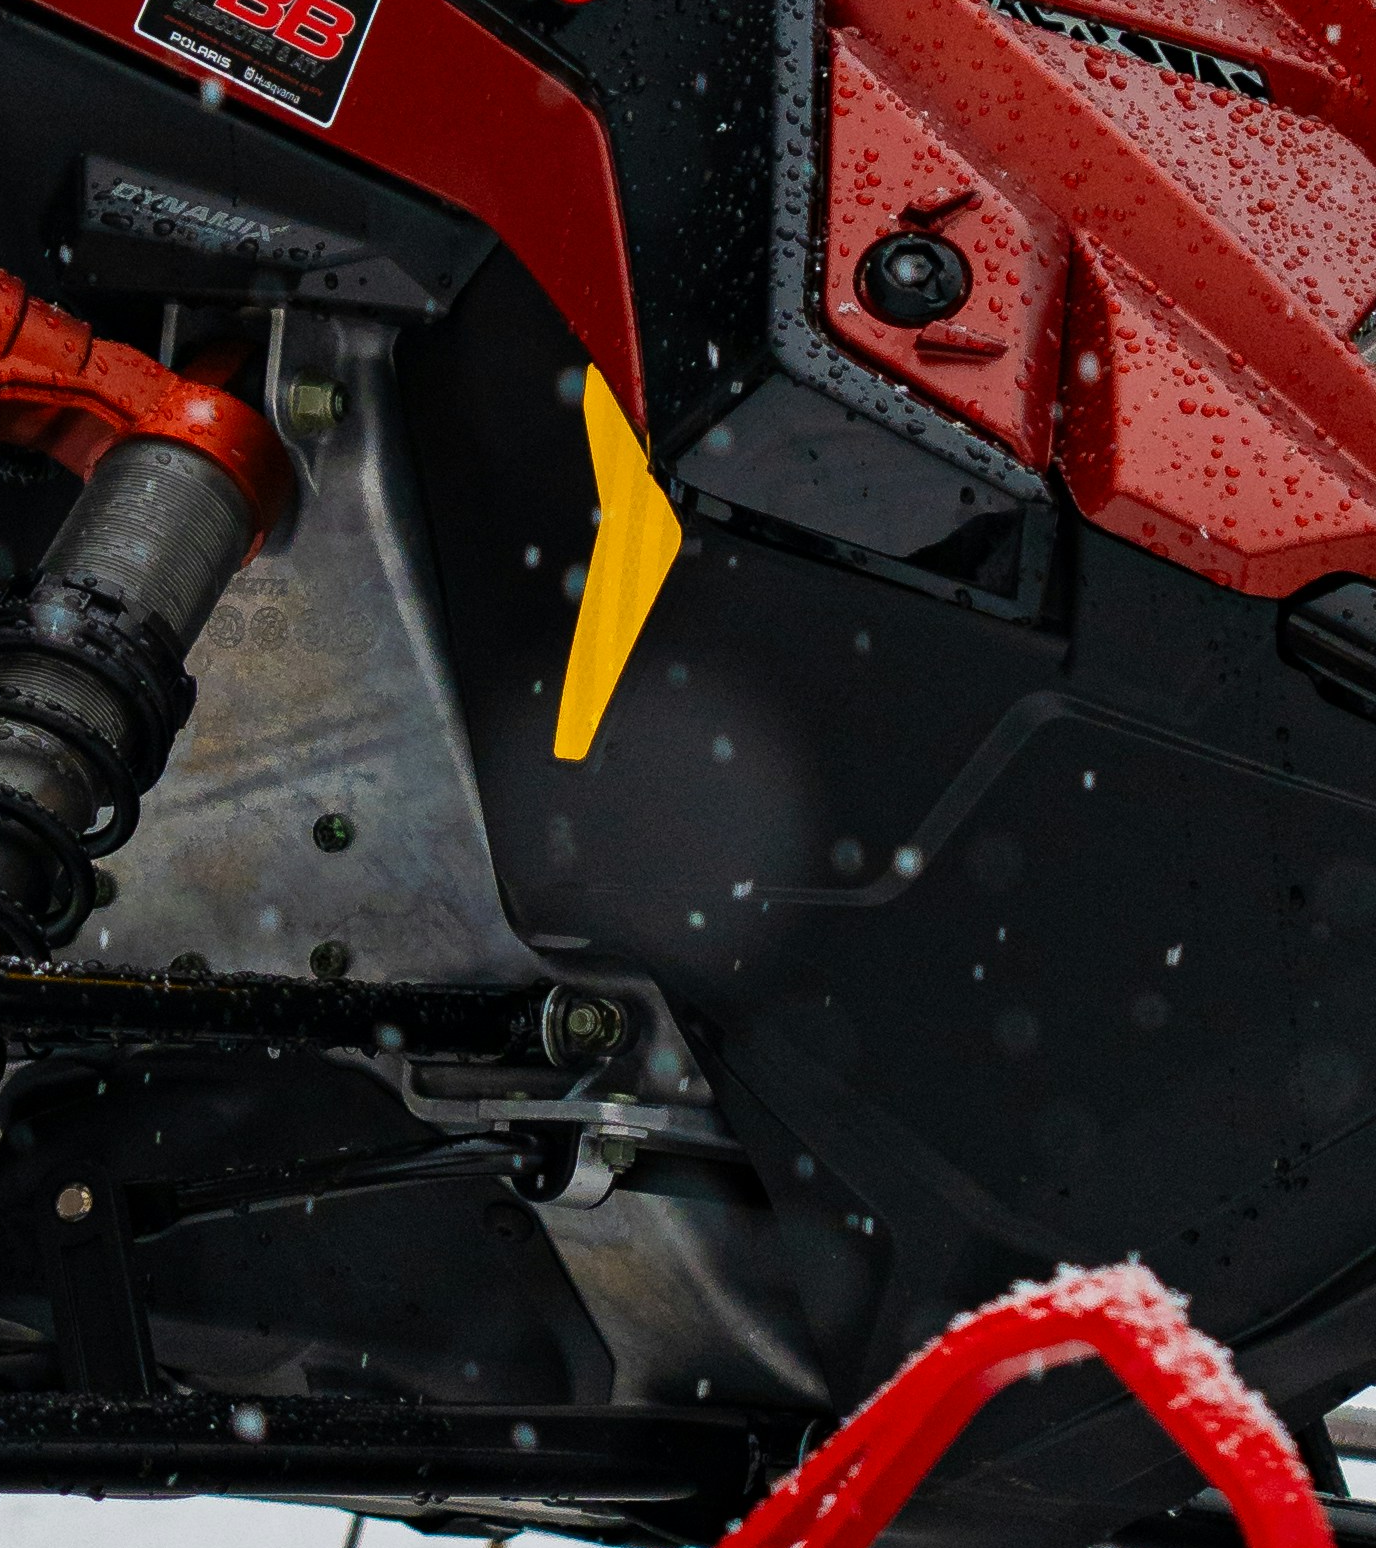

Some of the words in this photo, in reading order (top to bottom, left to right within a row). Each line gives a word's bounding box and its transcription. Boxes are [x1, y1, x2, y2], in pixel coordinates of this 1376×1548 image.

[170, 32, 232, 68] POLARIS
[290, 53, 327, 79] ATV
[253, 72, 300, 104] Husqvarna
[111, 182, 289, 243] DYNAMIX
